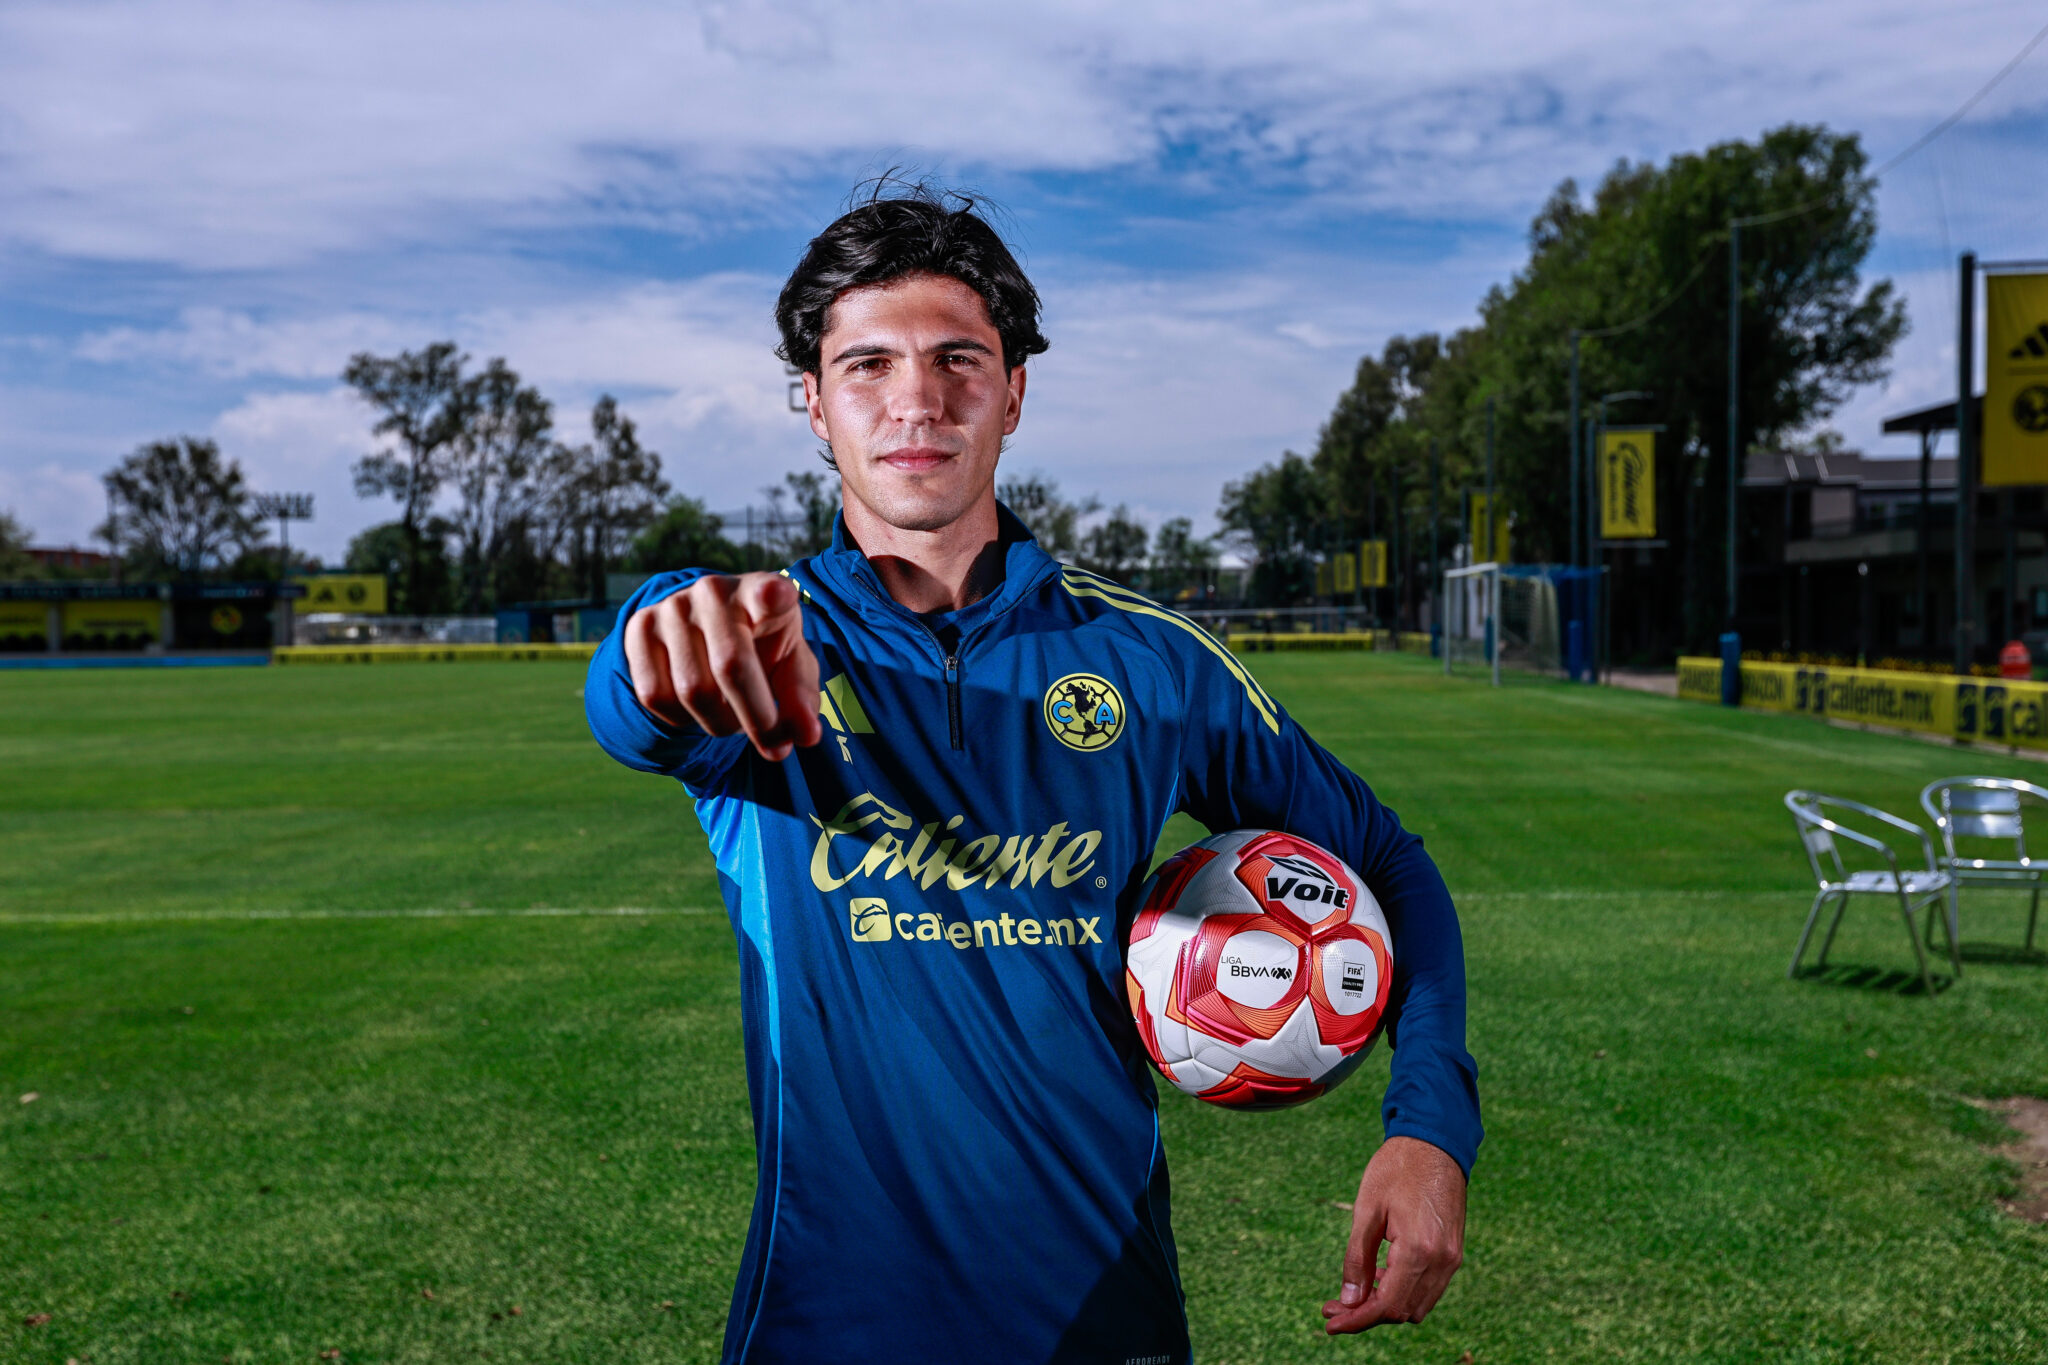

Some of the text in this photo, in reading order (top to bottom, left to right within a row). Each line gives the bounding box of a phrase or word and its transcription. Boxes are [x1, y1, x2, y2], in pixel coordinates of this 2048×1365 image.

[808, 789, 1102, 892] Caliente
[1266, 877, 1349, 909] Voit
[1221, 956, 1242, 965] LIGA
[1231, 965, 1270, 977] BBVA
[1347, 967, 1361, 976] FIFA
